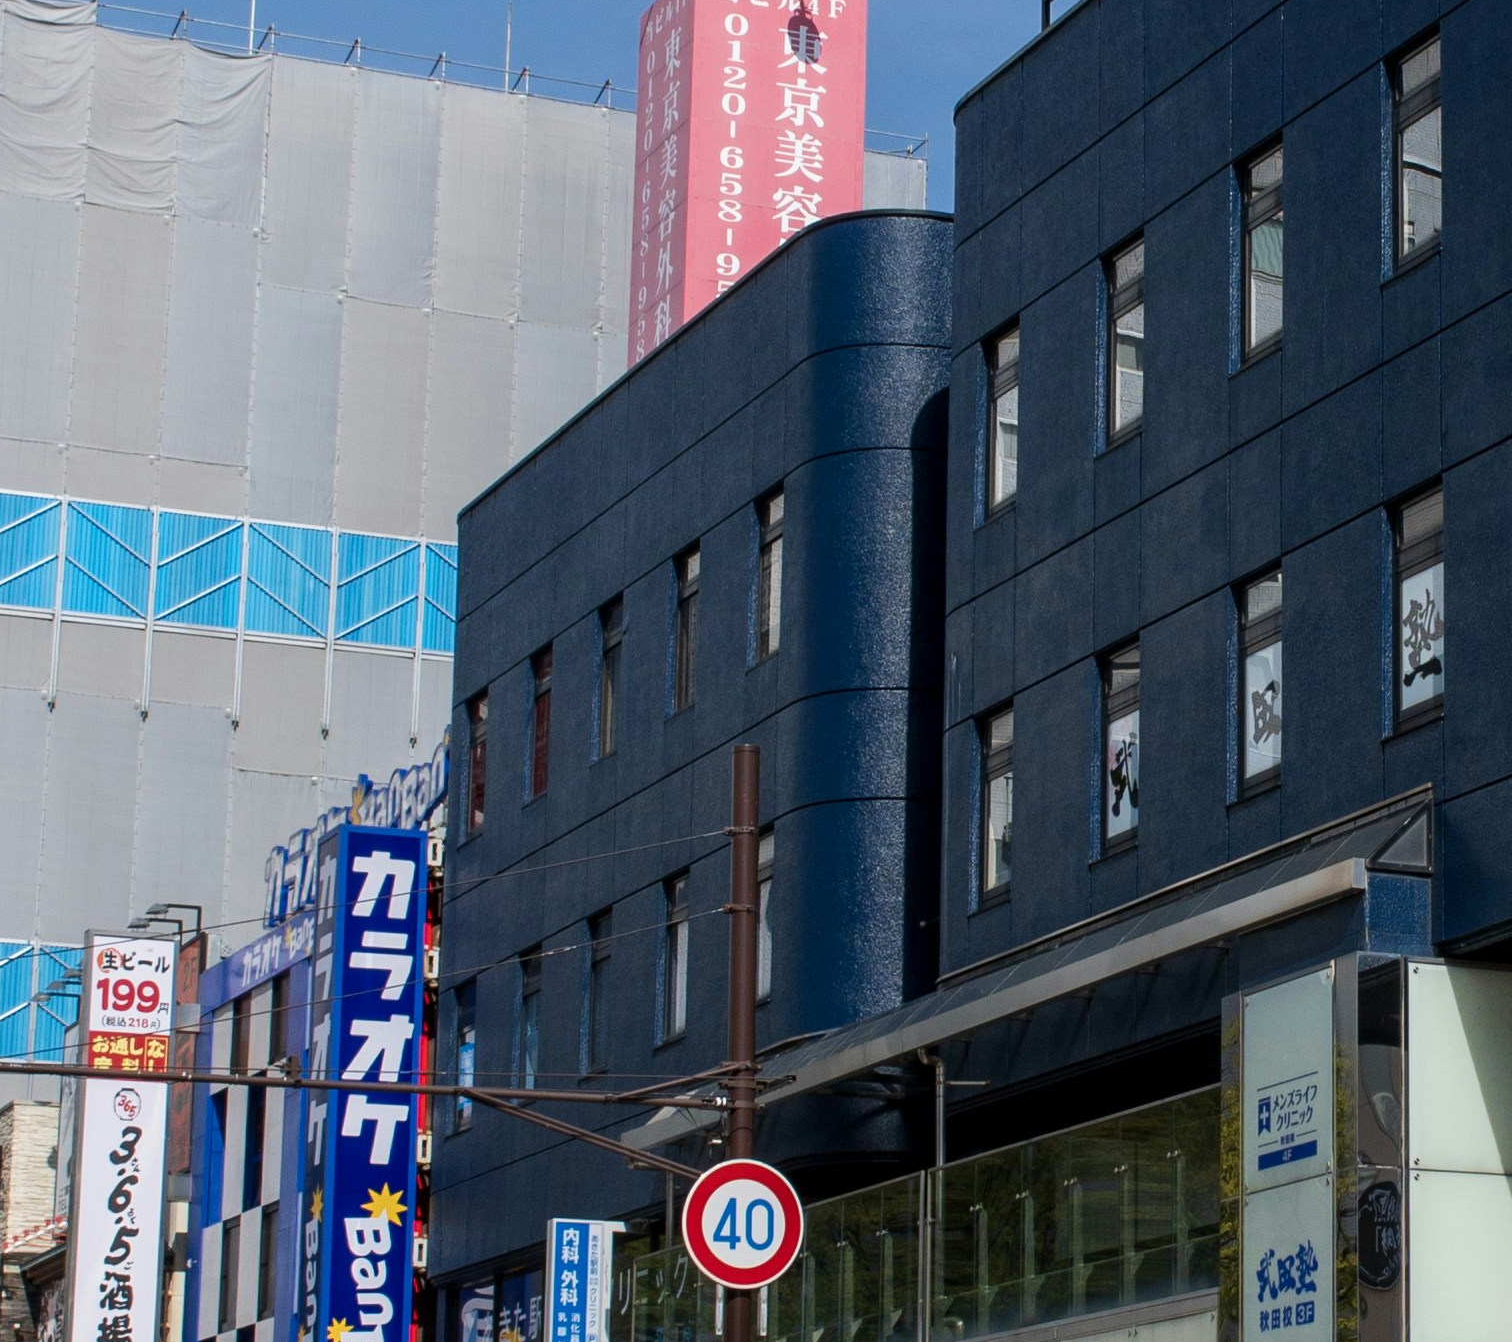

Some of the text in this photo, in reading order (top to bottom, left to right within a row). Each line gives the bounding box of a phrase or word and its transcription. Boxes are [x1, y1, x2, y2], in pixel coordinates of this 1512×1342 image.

[772, 24, 829, 249] 東京美容
[654, 25, 682, 347] 東京美容外科
[100, 948, 170, 973] 生ビール
[242, 935, 283, 989] カラオケ
[96, 979, 170, 1014] 199円
[307, 854, 337, 1166] カラオケ
[341, 850, 417, 1166] カラオケ
[92, 1035, 144, 1056] お通し
[1272, 1084, 1318, 1112] メンズライフ
[1275, 1104, 1314, 1132] クリニック
[1282, 1149, 1293, 1162] 4F
[713, 1197, 775, 1251] 40
[559, 1227, 580, 1307] 内科 外科
[1256, 1239, 1318, 1304] 武田塾
[589, 1288, 598, 1328] クリニック
[1259, 1305, 1314, 1334] 秋田校 3F
